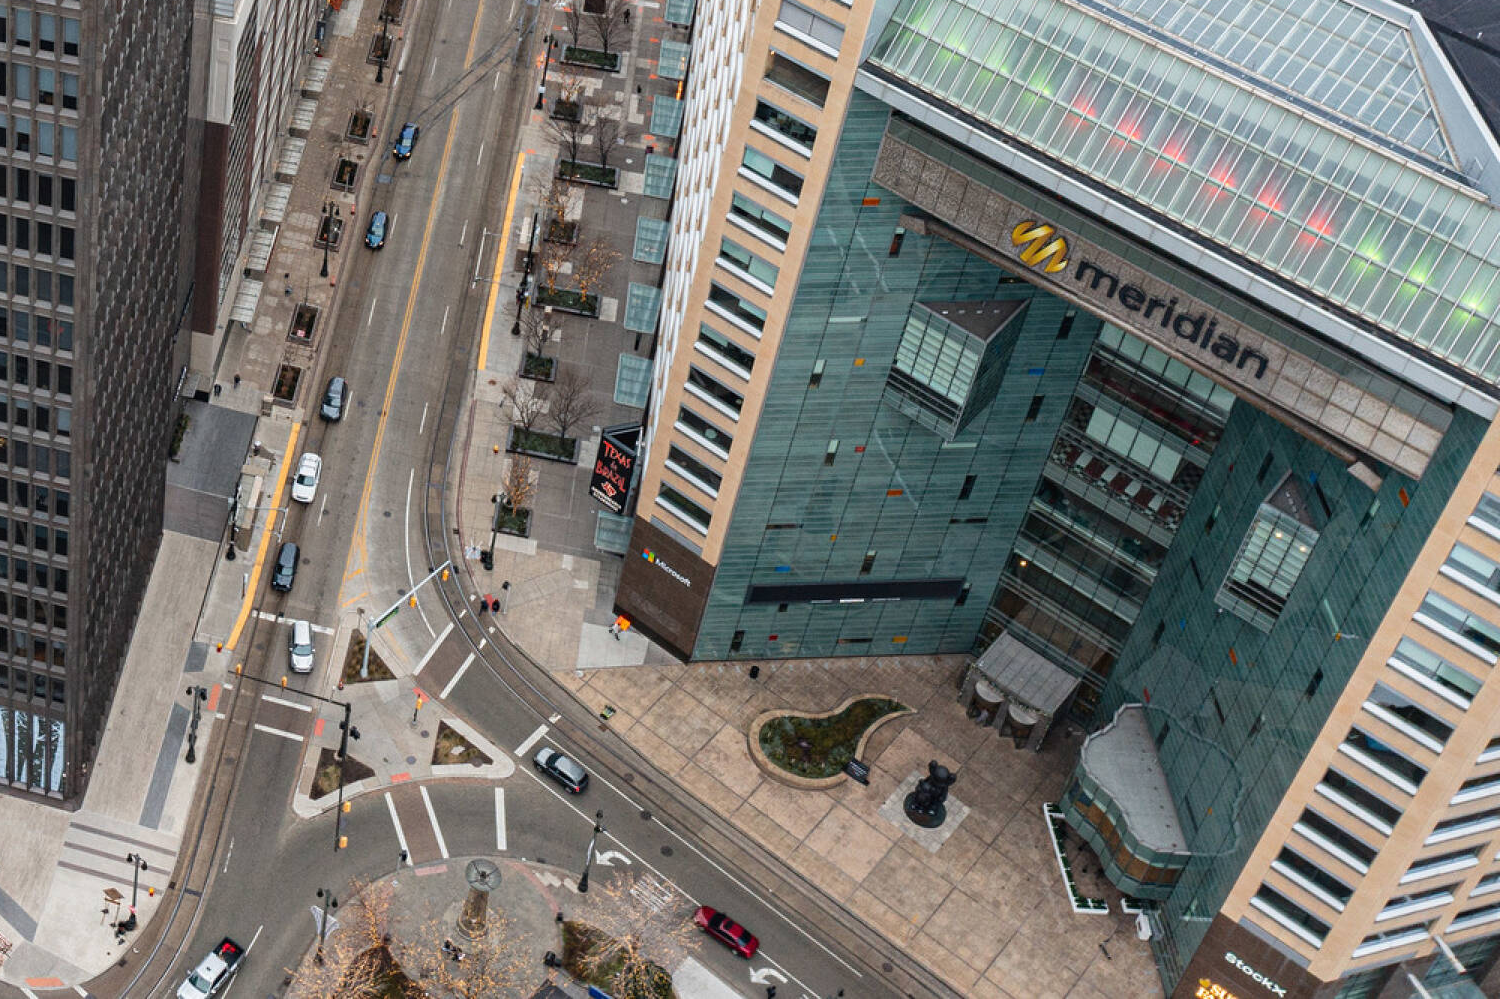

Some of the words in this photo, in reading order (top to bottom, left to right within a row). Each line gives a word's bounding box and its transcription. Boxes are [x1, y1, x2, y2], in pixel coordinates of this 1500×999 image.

[1074, 259, 1269, 380] meridian
[603, 440, 633, 469] TEXAS
[655, 558, 691, 588] Microsoft
